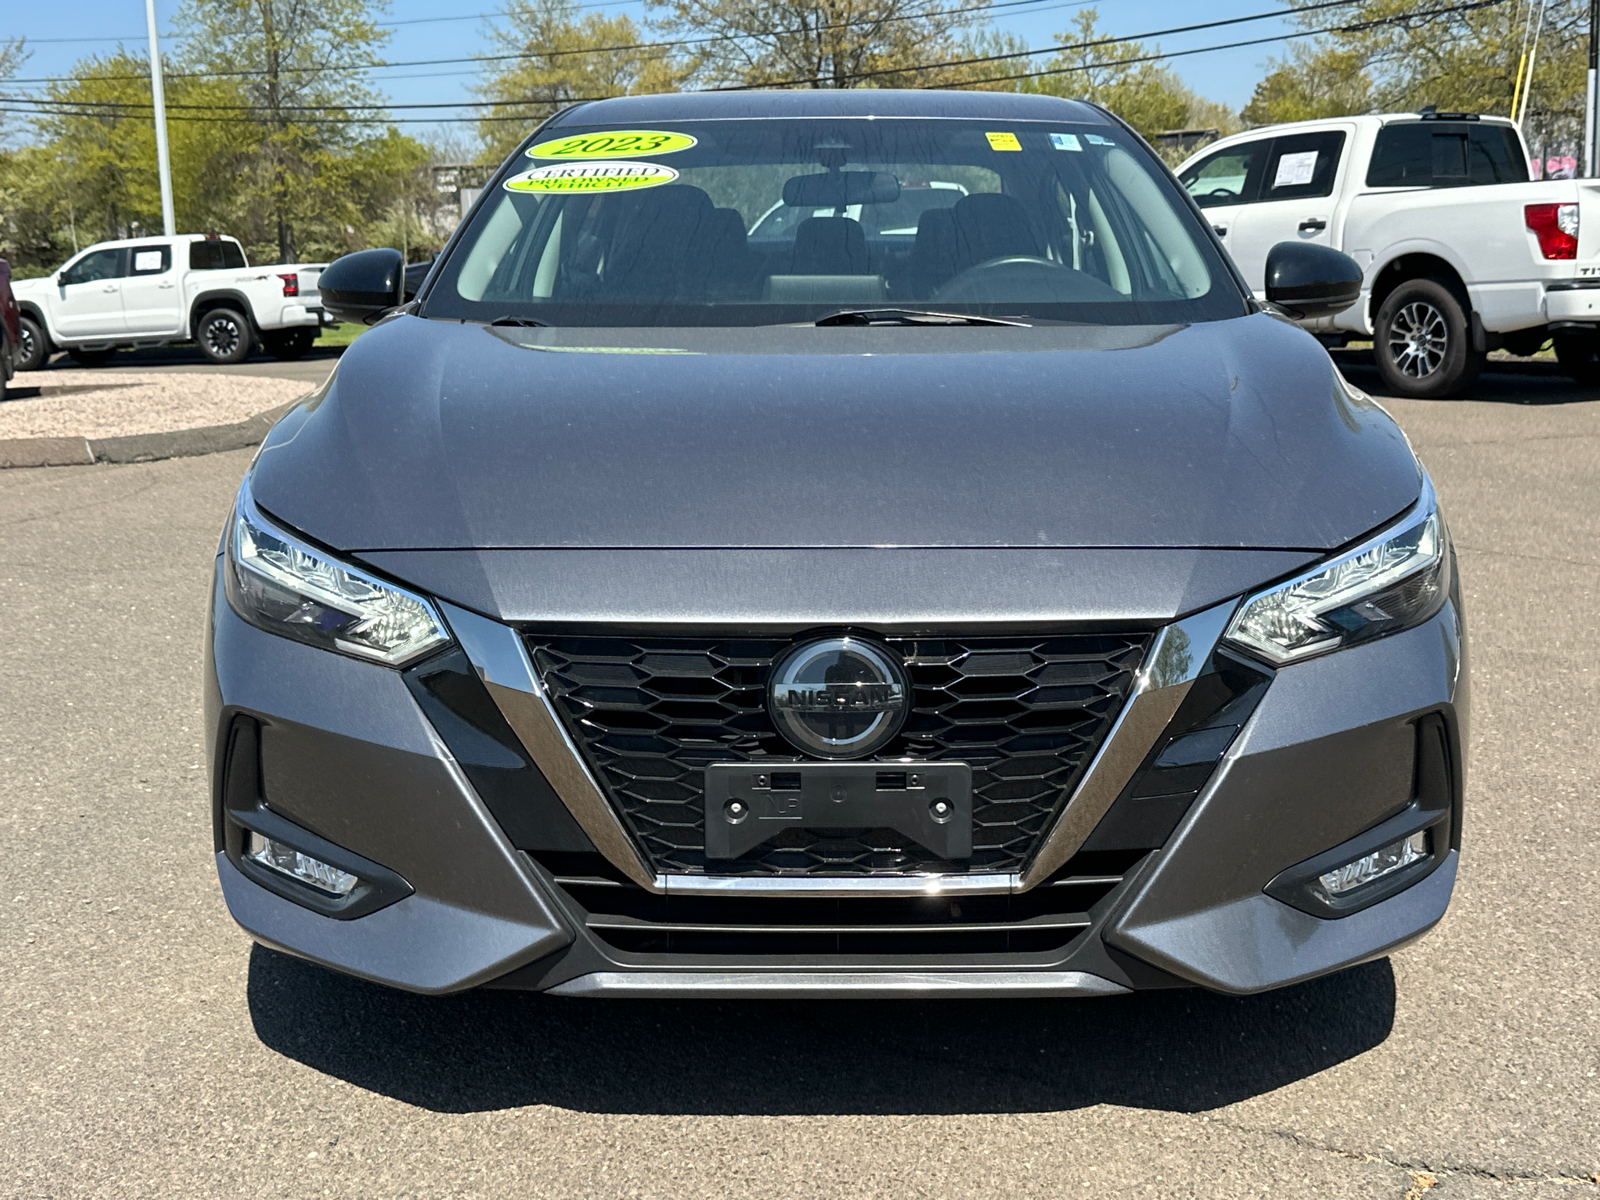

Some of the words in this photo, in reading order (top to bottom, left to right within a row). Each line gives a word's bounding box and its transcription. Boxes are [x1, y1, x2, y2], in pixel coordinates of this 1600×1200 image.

[551, 136, 671, 156] 2023
[527, 167, 661, 180] CERTIFIED
[788, 689, 889, 706] NISSAN
